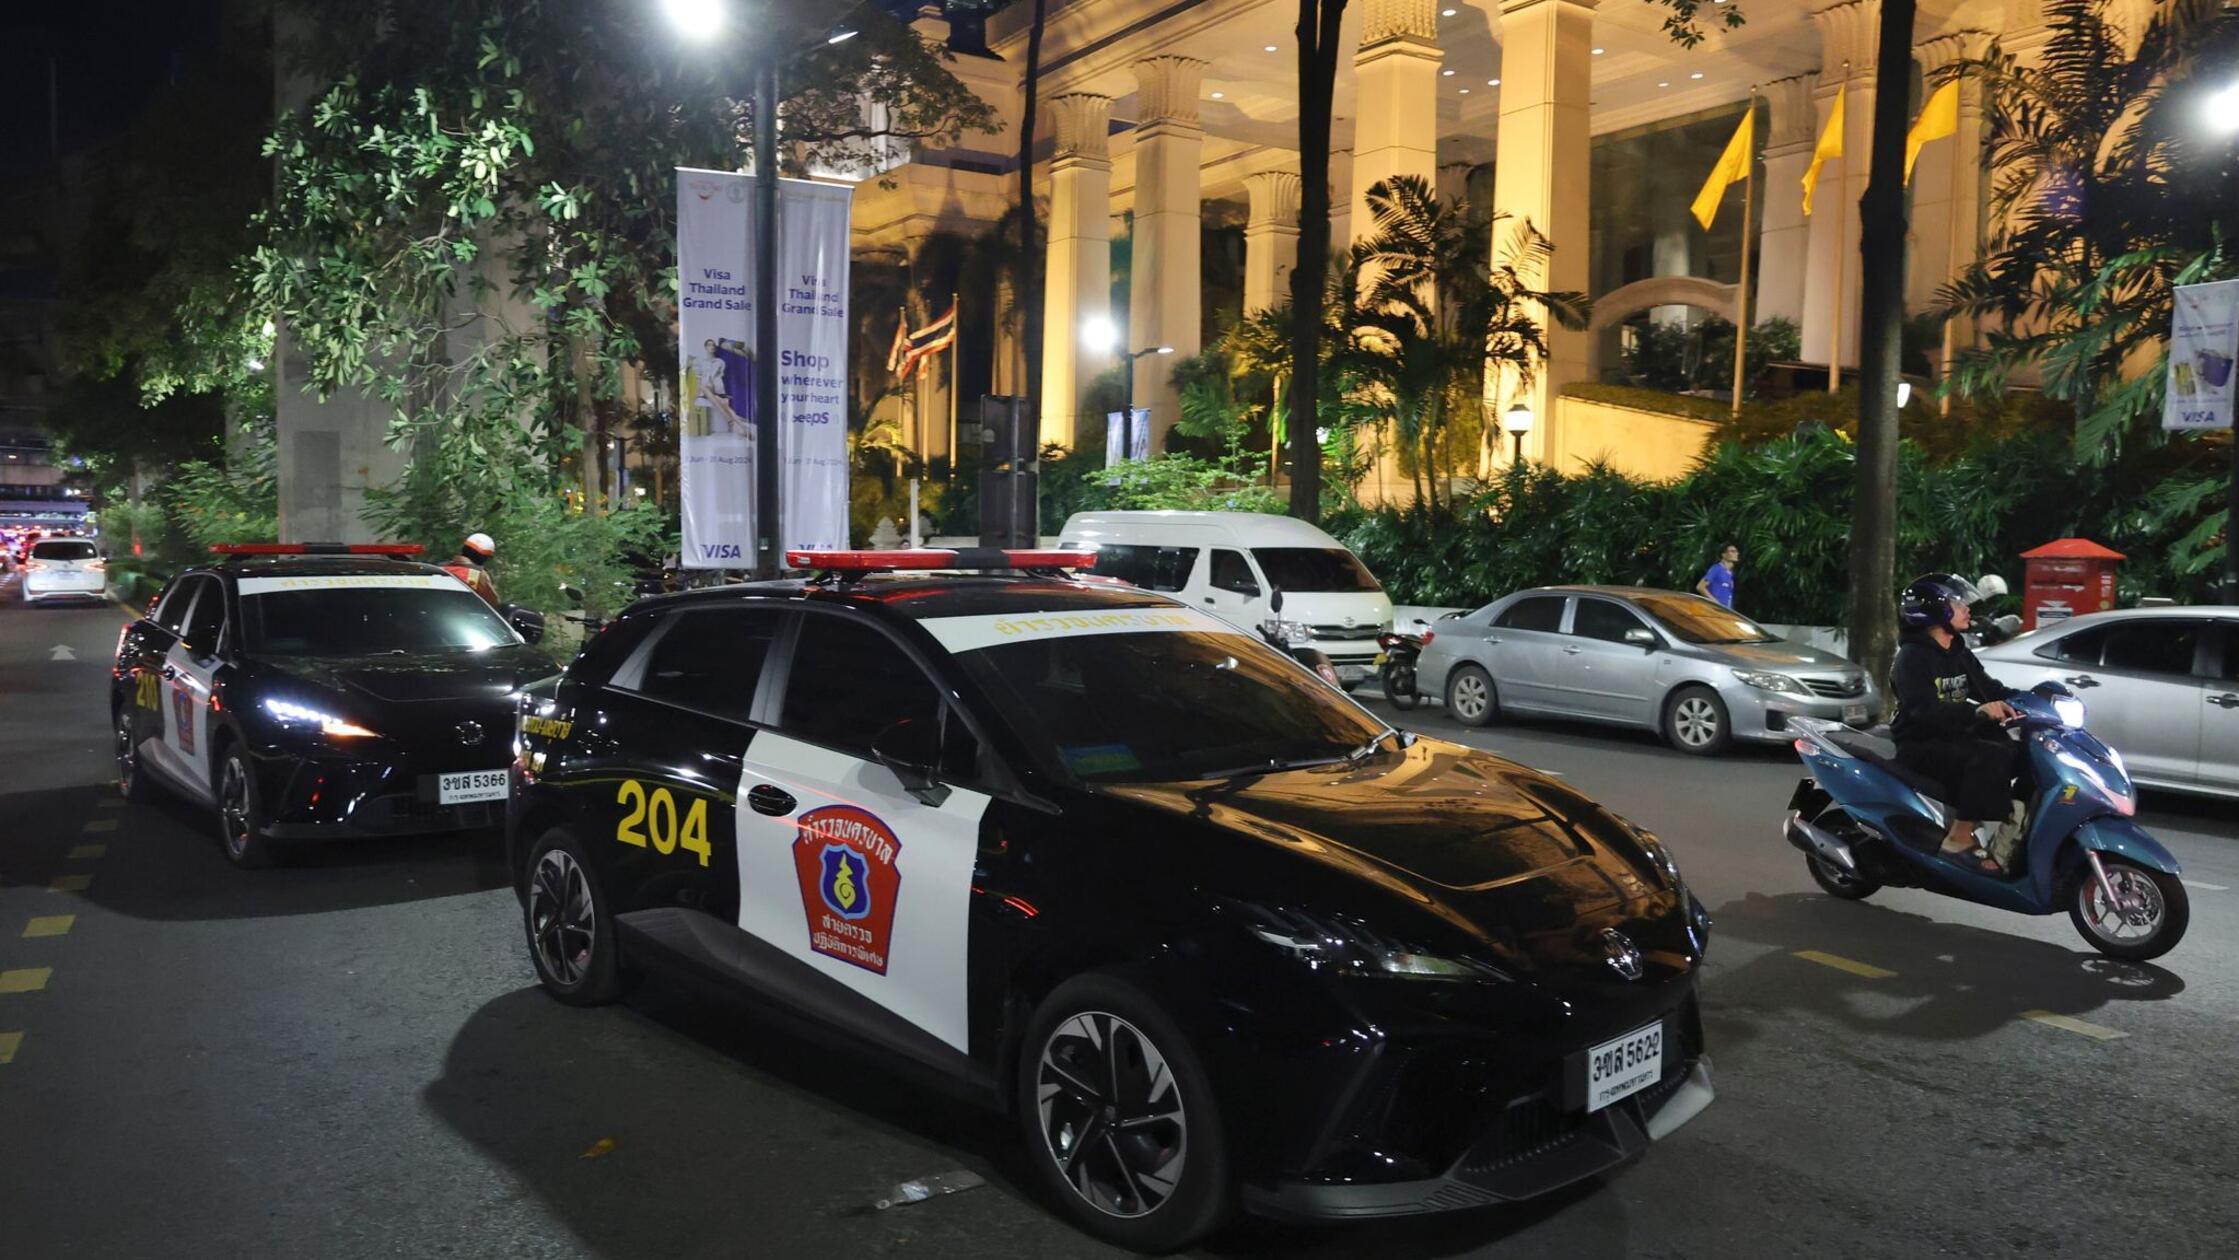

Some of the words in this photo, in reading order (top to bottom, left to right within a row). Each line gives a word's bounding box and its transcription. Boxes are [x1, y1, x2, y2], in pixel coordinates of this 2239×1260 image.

[703, 268, 731, 280] Visa
[689, 282, 745, 296] Thailand
[789, 288, 839, 303] Thaind
[683, 297, 722, 310] Grand
[725, 299, 752, 311] Sale
[820, 306, 844, 318] Sale
[781, 350, 829, 371] Shop
[781, 374, 844, 388] wherever
[810, 394, 840, 404] heart
[2182, 411, 2215, 423] VISA
[702, 544, 741, 559] VISA
[474, 773, 506, 788] 5366
[617, 779, 712, 867] 204
[802, 815, 893, 865] ตำรวจนครบาล
[1627, 1031, 1660, 1068] 5622
